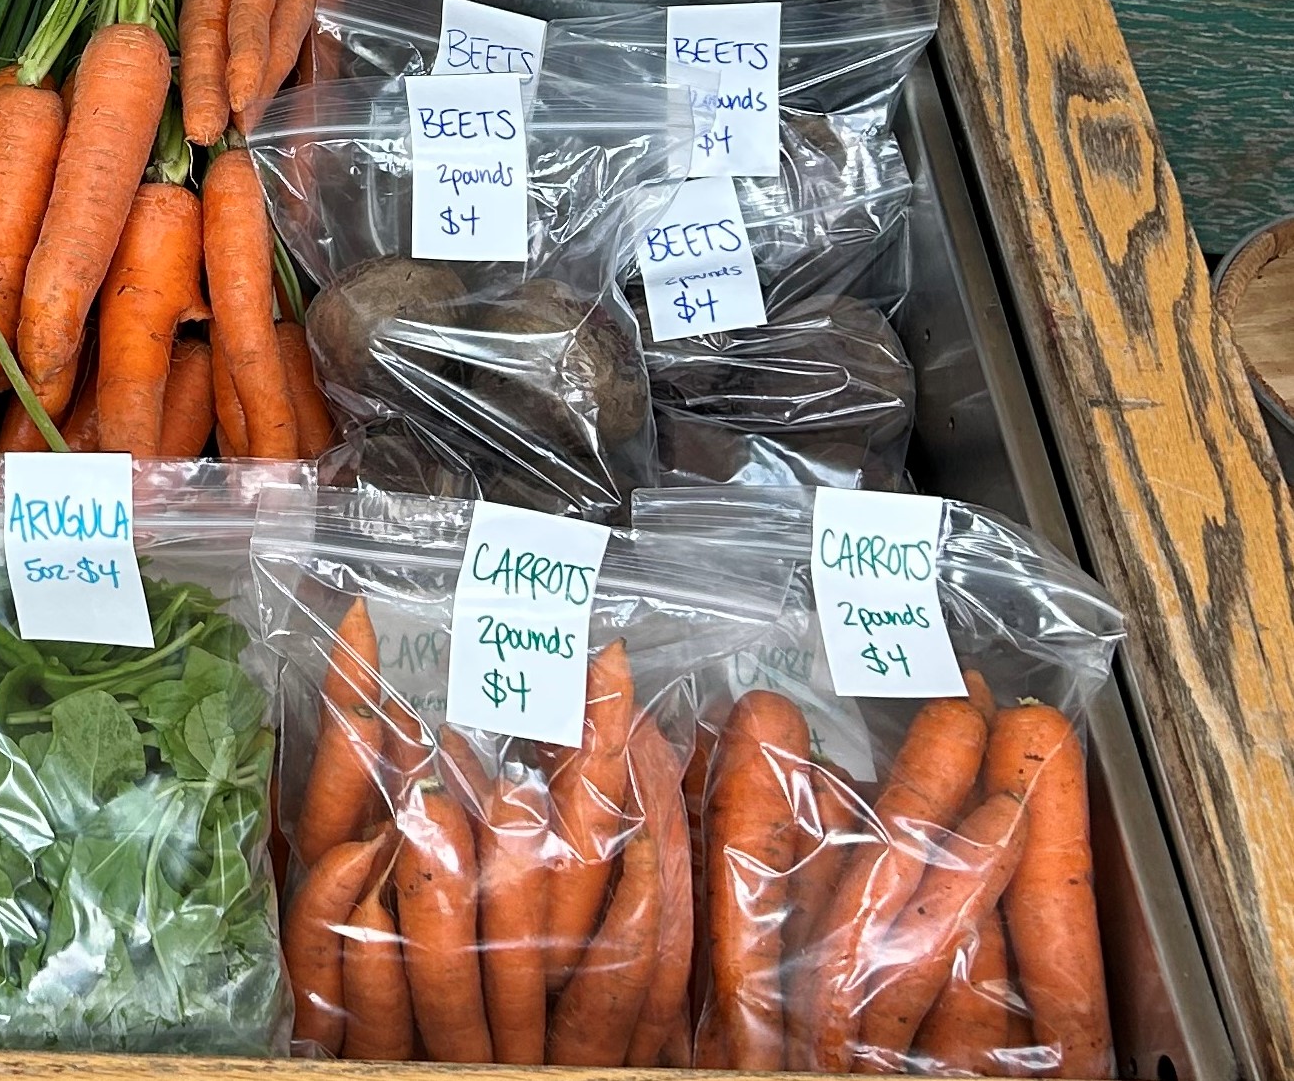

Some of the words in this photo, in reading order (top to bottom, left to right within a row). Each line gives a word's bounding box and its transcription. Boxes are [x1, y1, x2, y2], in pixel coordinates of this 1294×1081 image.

[447, 29, 534, 85] BEETS
[673, 37, 769, 70] BEETS
[417, 108, 517, 140] BEETS
[697, 125, 734, 158] $4
[439, 205, 481, 236] $4
[646, 219, 742, 262] BEETS
[673, 288, 720, 324] $4
[9, 492, 130, 543] ARUGULA
[473, 543, 596, 605] CARROTS
[820, 528, 932, 582] CARROTS
[860, 641, 912, 677] $4
[481, 668, 532, 714] $4
